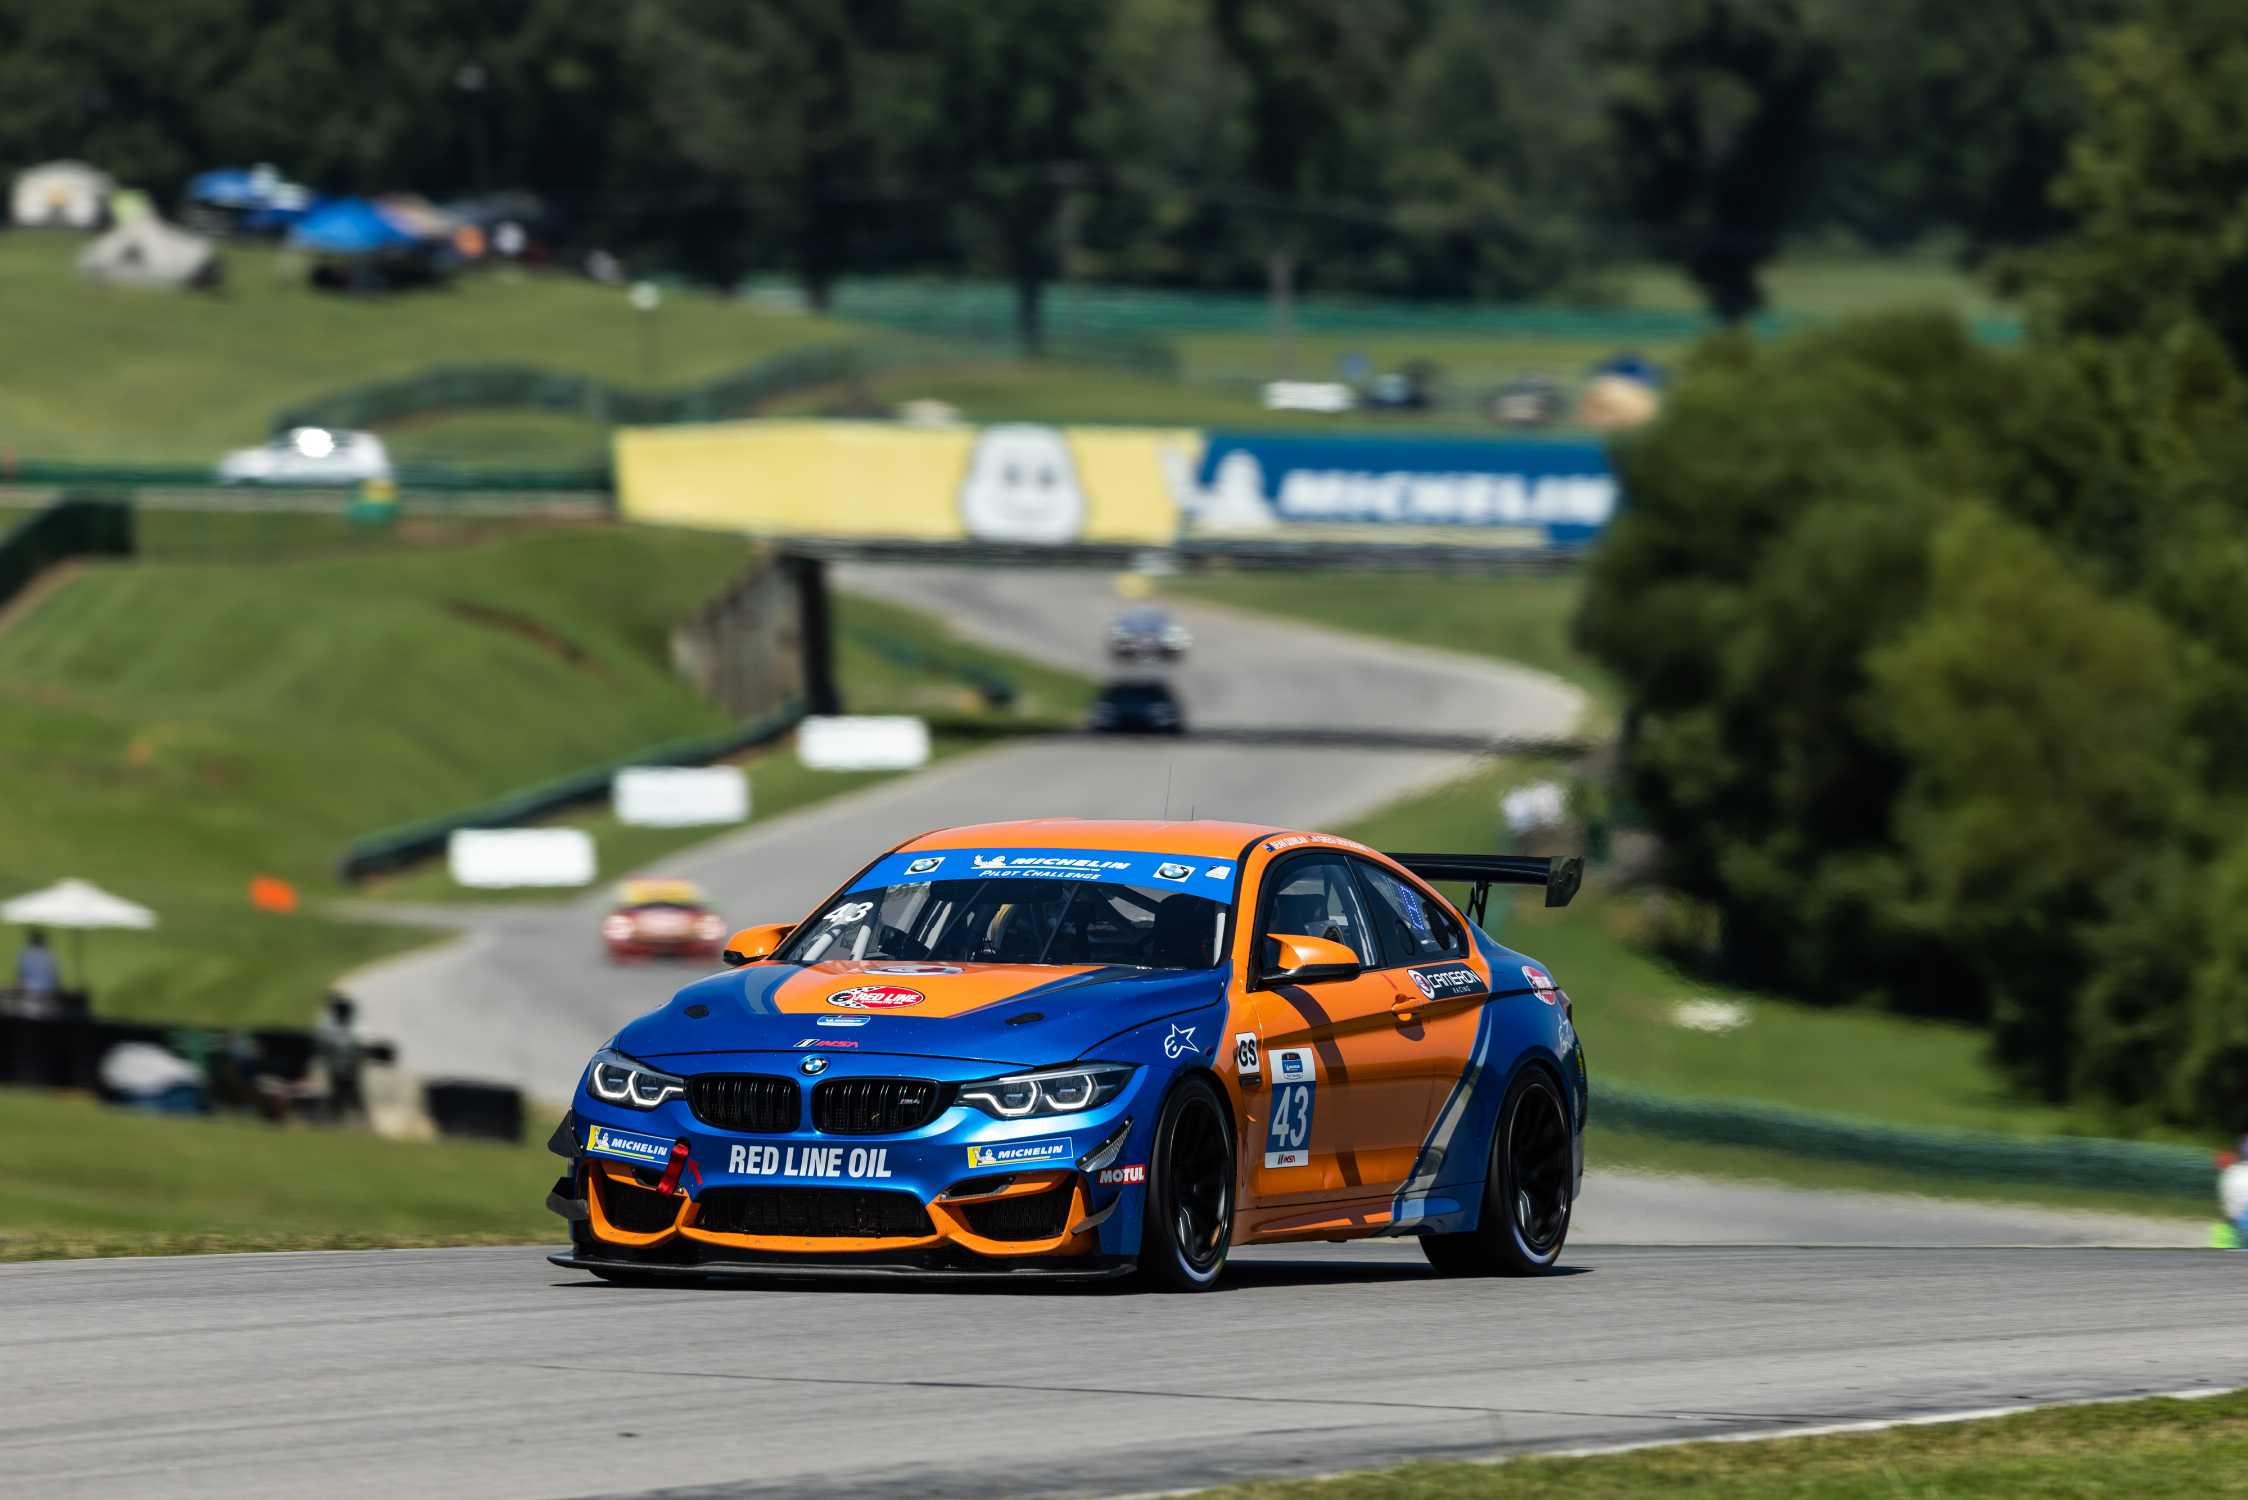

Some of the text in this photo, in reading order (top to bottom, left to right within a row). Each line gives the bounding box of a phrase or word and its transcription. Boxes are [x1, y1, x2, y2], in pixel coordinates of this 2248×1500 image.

[1277, 468, 1619, 525] MICHELIN
[1009, 857, 1132, 870] MICHELIN
[979, 869, 1102, 880] PILOT CHALLENGE
[1426, 969, 1482, 989] CAMERON
[853, 992, 885, 1001] RED
[885, 993, 920, 1003] LINE
[1238, 1038, 1257, 1067] GS
[1271, 1085, 1309, 1147] 43
[611, 1137, 668, 1156] MICHELIN
[997, 1144, 1064, 1160] MICHELIN
[728, 1144, 892, 1178] RED LINE OIL
[1099, 1165, 1146, 1184] MOTUL
